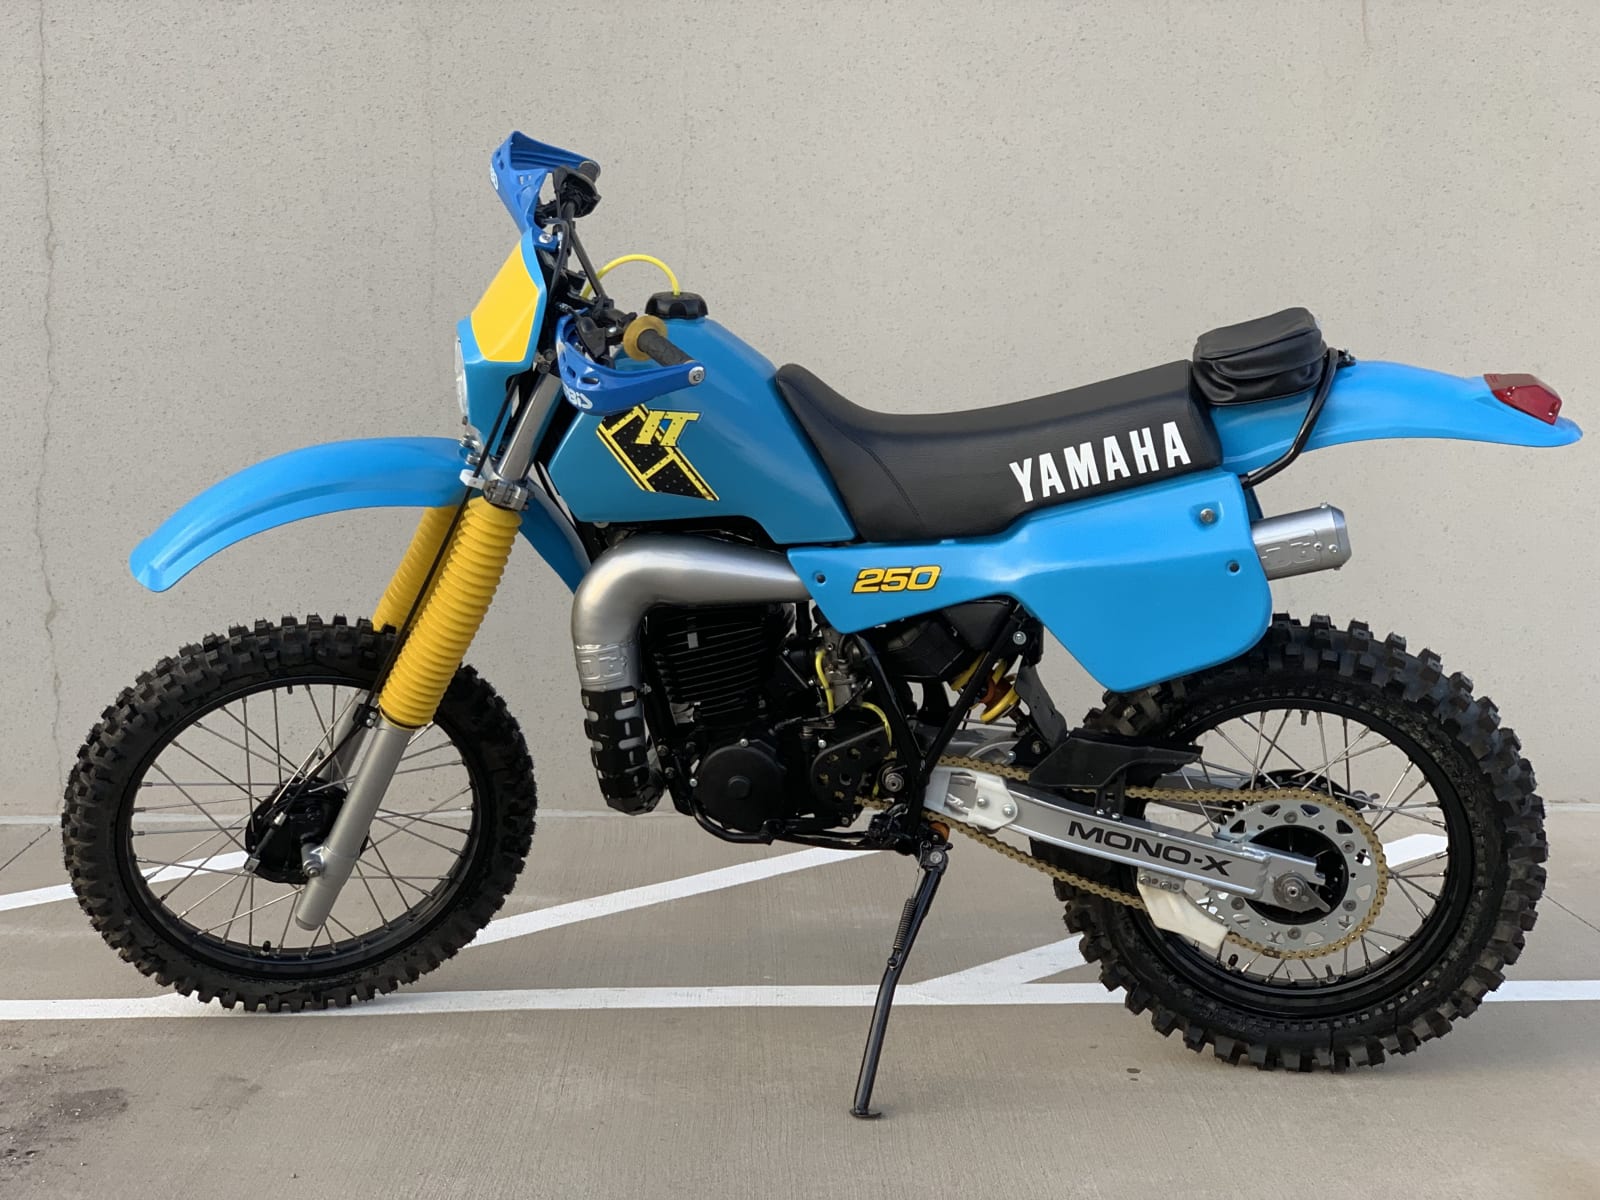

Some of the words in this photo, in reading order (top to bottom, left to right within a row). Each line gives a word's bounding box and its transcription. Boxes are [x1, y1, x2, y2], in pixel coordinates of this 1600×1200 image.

[635, 410, 700, 446] IT
[1009, 421, 1192, 503] YAMAHA
[852, 565, 941, 593] 250
[1068, 821, 1232, 876] MONO-X
